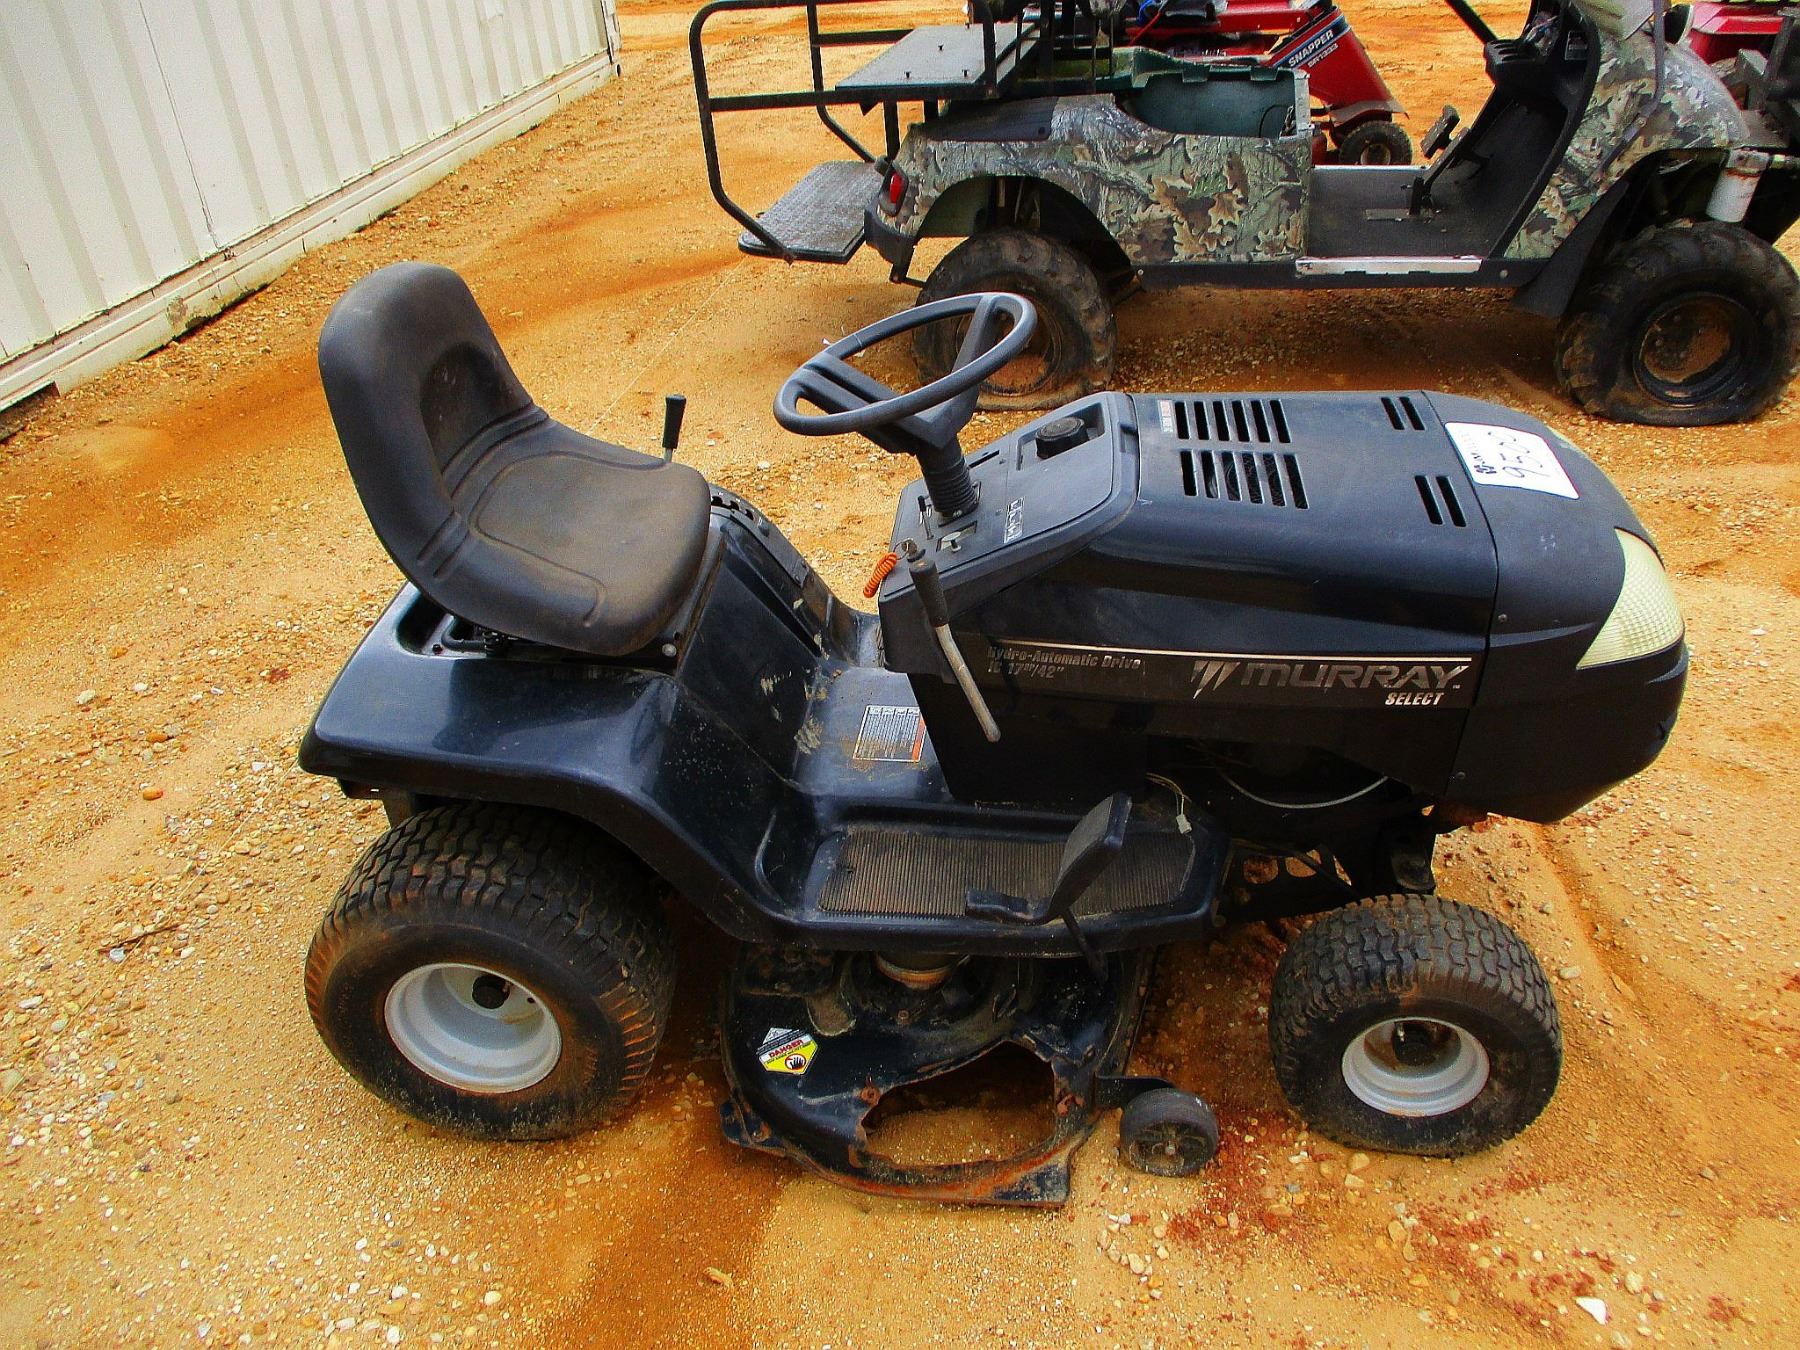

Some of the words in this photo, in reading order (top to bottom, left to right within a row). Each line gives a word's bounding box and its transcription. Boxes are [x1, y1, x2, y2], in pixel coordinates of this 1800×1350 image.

[1288, 29, 1334, 67] SNAPPER
[1101, 655, 1141, 669] Drive
[1241, 662, 1469, 689] MURRAY
[1385, 692, 1444, 706] SELECT
[768, 1039, 804, 1058] DANGER
